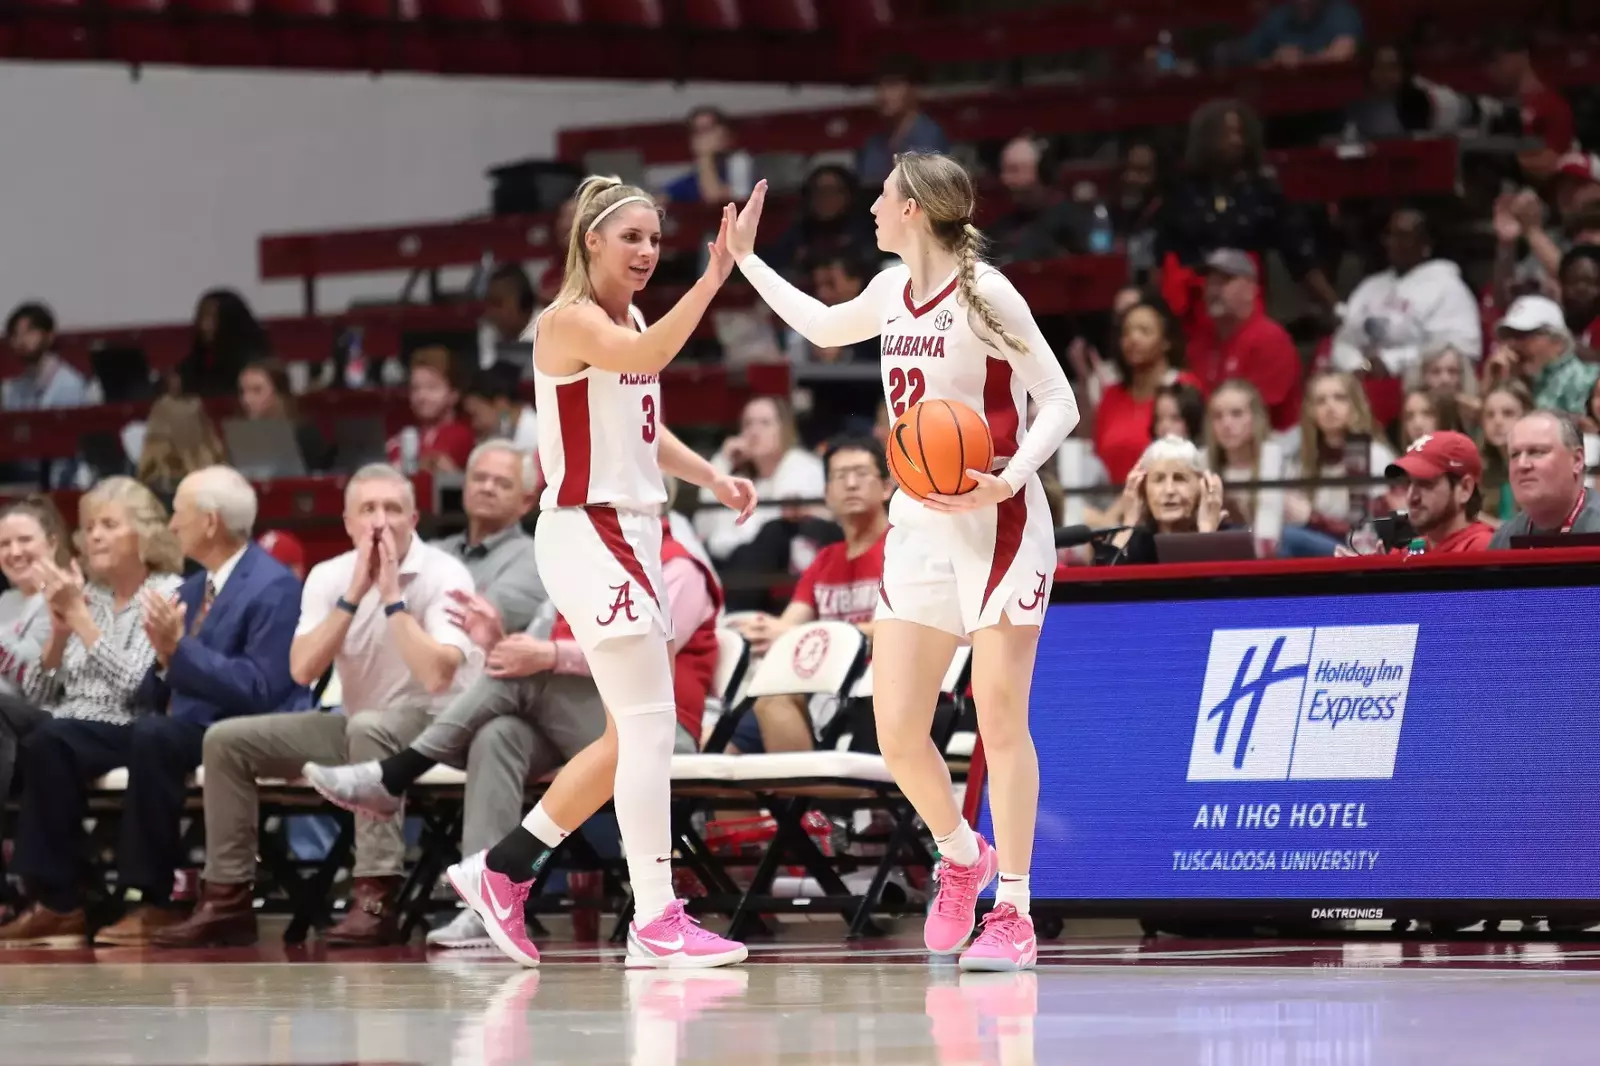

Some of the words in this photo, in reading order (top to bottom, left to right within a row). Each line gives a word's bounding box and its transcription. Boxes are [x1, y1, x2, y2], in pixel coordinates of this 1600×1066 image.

[881, 335, 945, 358] ALABAMA
[889, 367, 925, 418] 22
[641, 394, 656, 444] 3
[1314, 658, 1376, 687] Holiday
[1307, 689, 1398, 730] Express
[1193, 803, 1229, 830] AN
[1235, 802, 1281, 830] IHG
[1289, 802, 1369, 829] HOTEL
[1172, 850, 1277, 872] TUSCALOOSA
[1280, 850, 1380, 871] UNIVERSITY
[1311, 907, 1384, 920] DAKTRONICS
